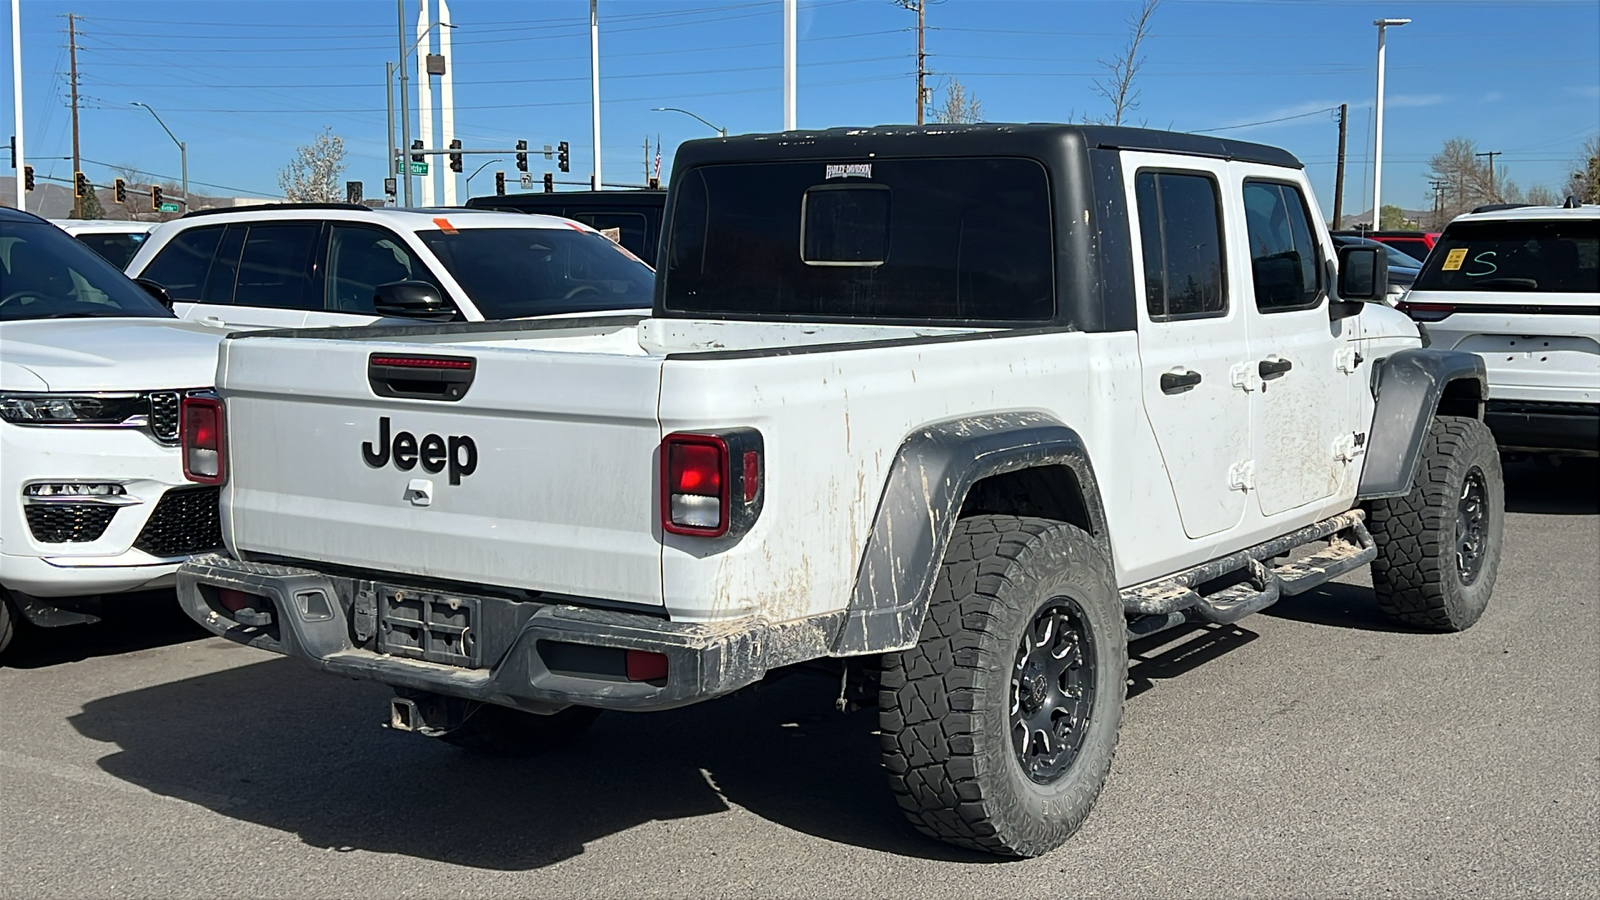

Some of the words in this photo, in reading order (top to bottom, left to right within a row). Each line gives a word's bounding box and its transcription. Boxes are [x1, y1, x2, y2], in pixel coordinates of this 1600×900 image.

[826, 163, 872, 180] HARLEY-DAVIDSON
[1466, 251, 1498, 277] S
[361, 416, 478, 486] Jeep
